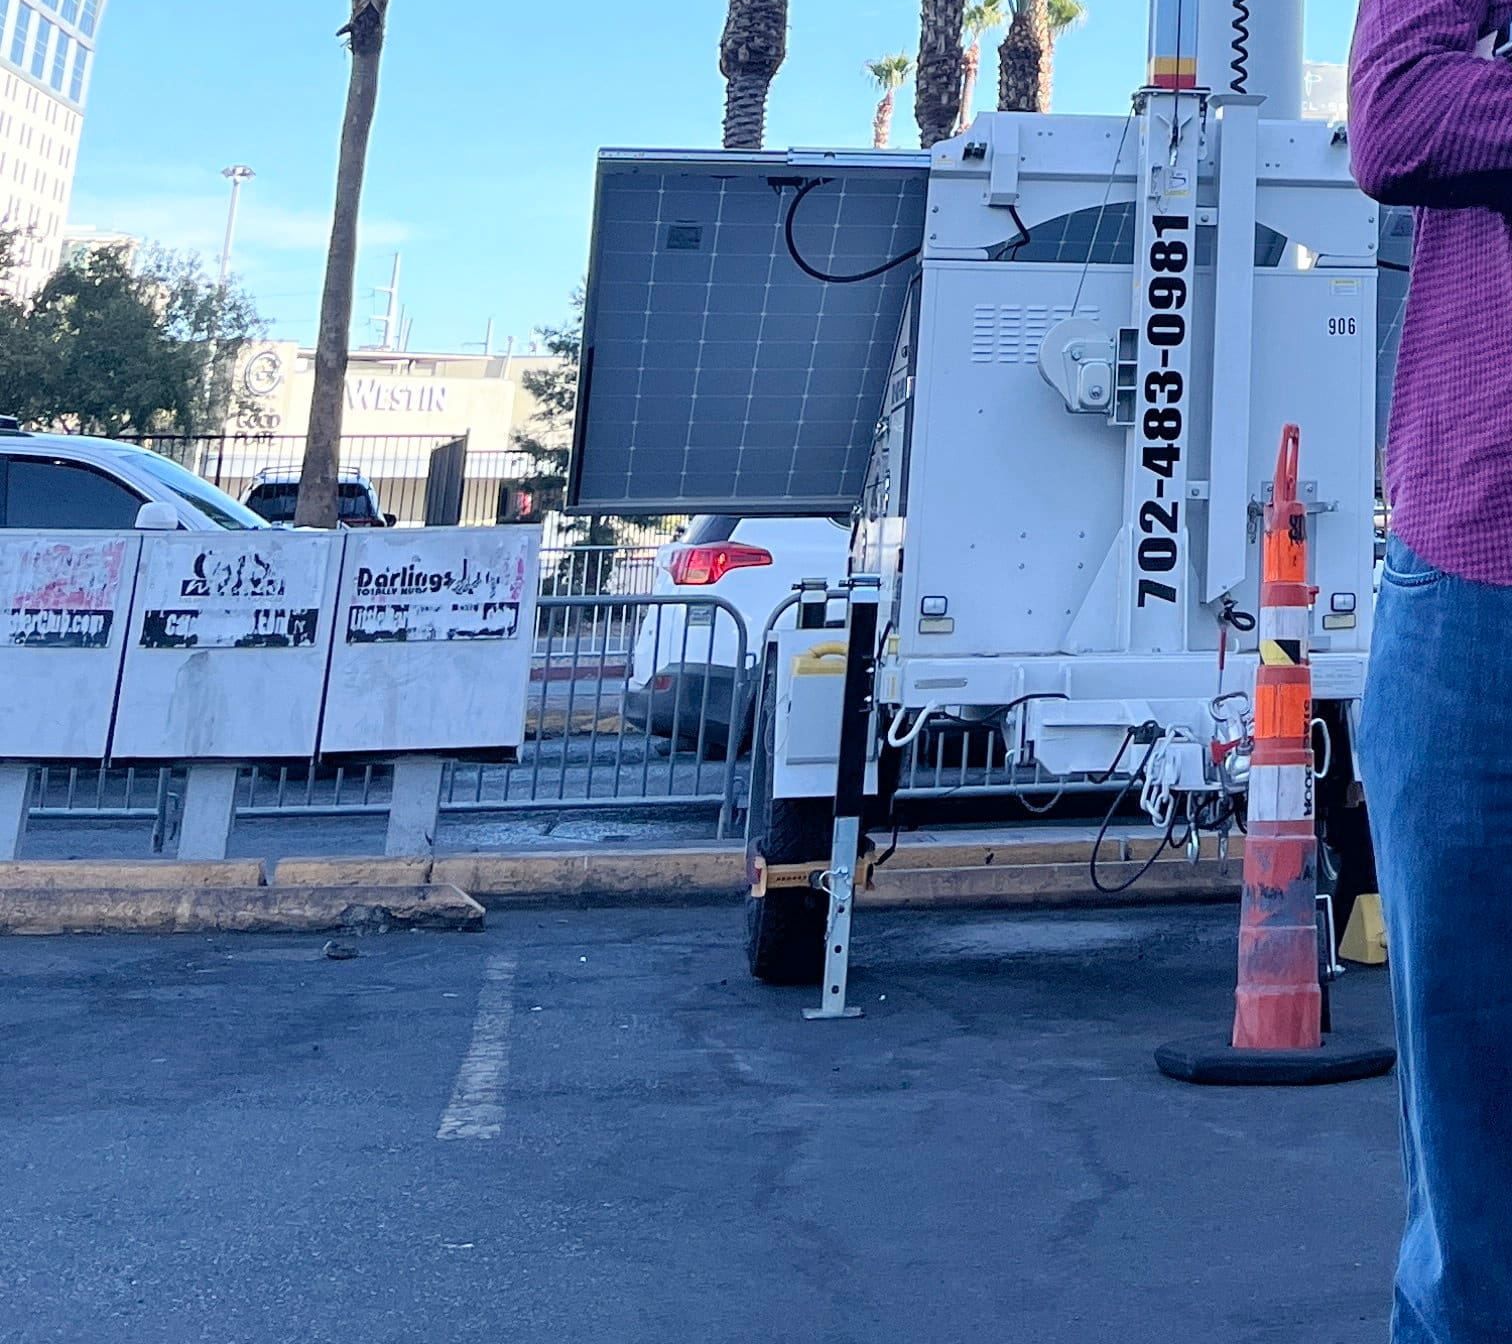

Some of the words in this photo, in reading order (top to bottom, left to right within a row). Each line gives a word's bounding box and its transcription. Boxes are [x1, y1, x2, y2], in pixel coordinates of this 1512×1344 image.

[1328, 316, 1356, 336] 906
[344, 379, 446, 412] WESTIN
[1137, 214, 1190, 609] 702-483-0981
